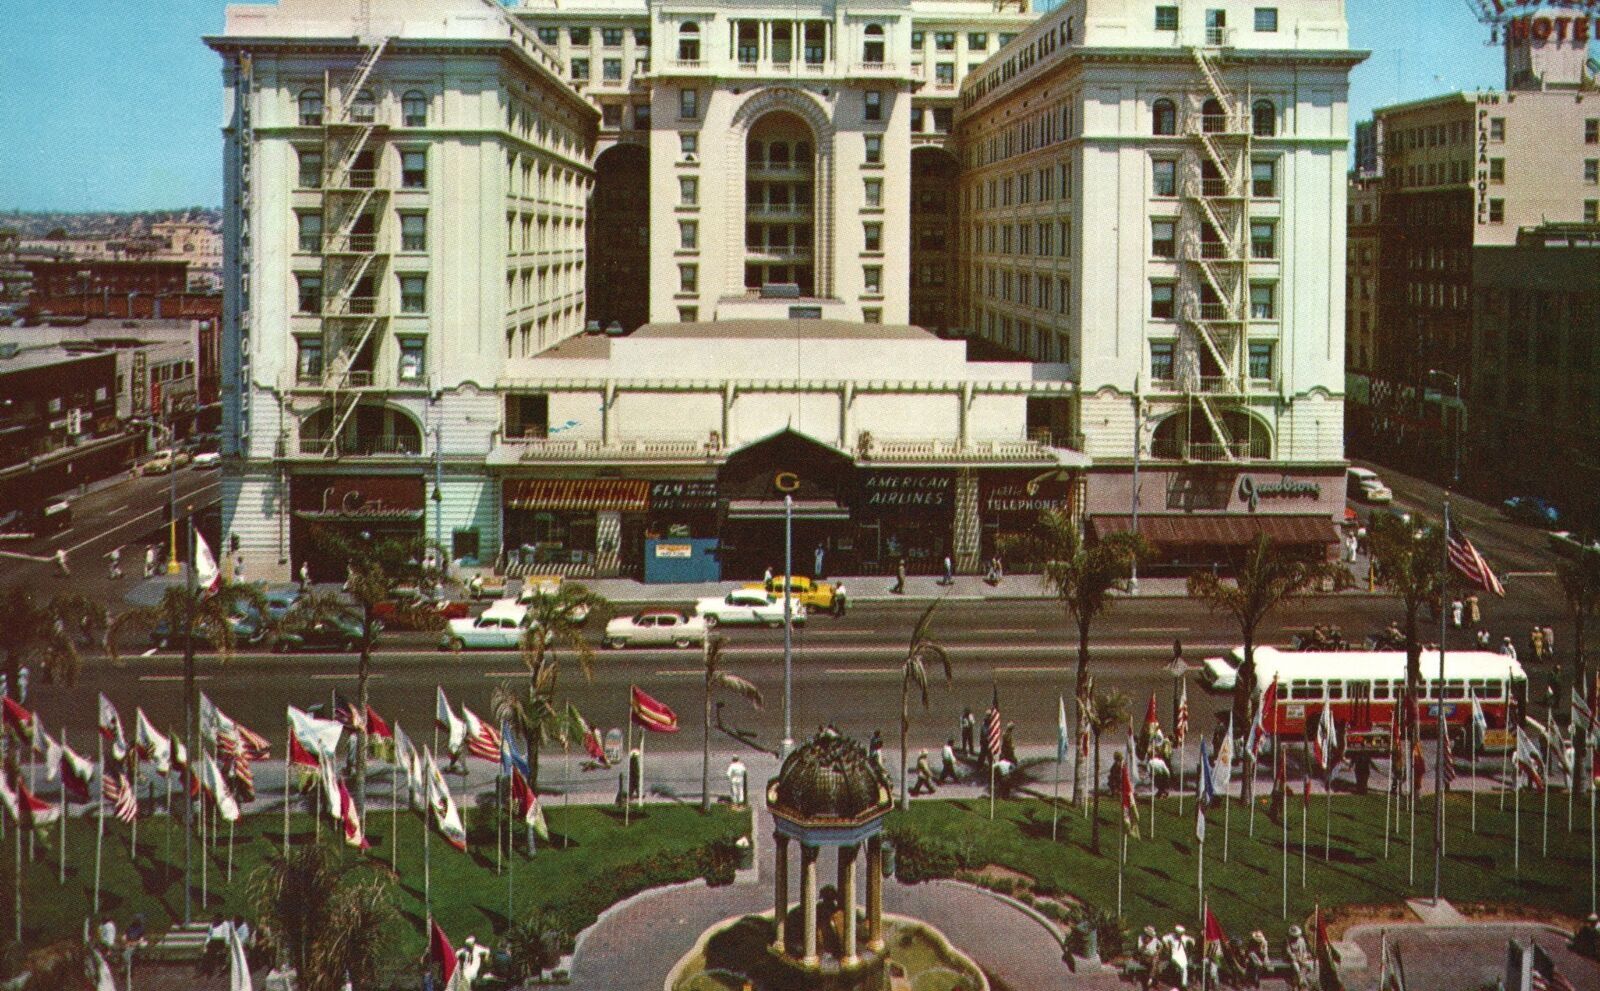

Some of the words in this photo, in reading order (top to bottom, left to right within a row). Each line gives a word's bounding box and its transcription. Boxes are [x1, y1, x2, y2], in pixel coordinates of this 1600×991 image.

[1478, 109, 1488, 164] PLAZA
[1477, 169, 1487, 225] HOTEL
[240, 162, 251, 293] GRANT
[241, 308, 251, 439] HOTEL
[652, 483, 684, 496] FLY
[866, 476, 950, 488] AMERICAN
[868, 491, 944, 505] AIRLINES
